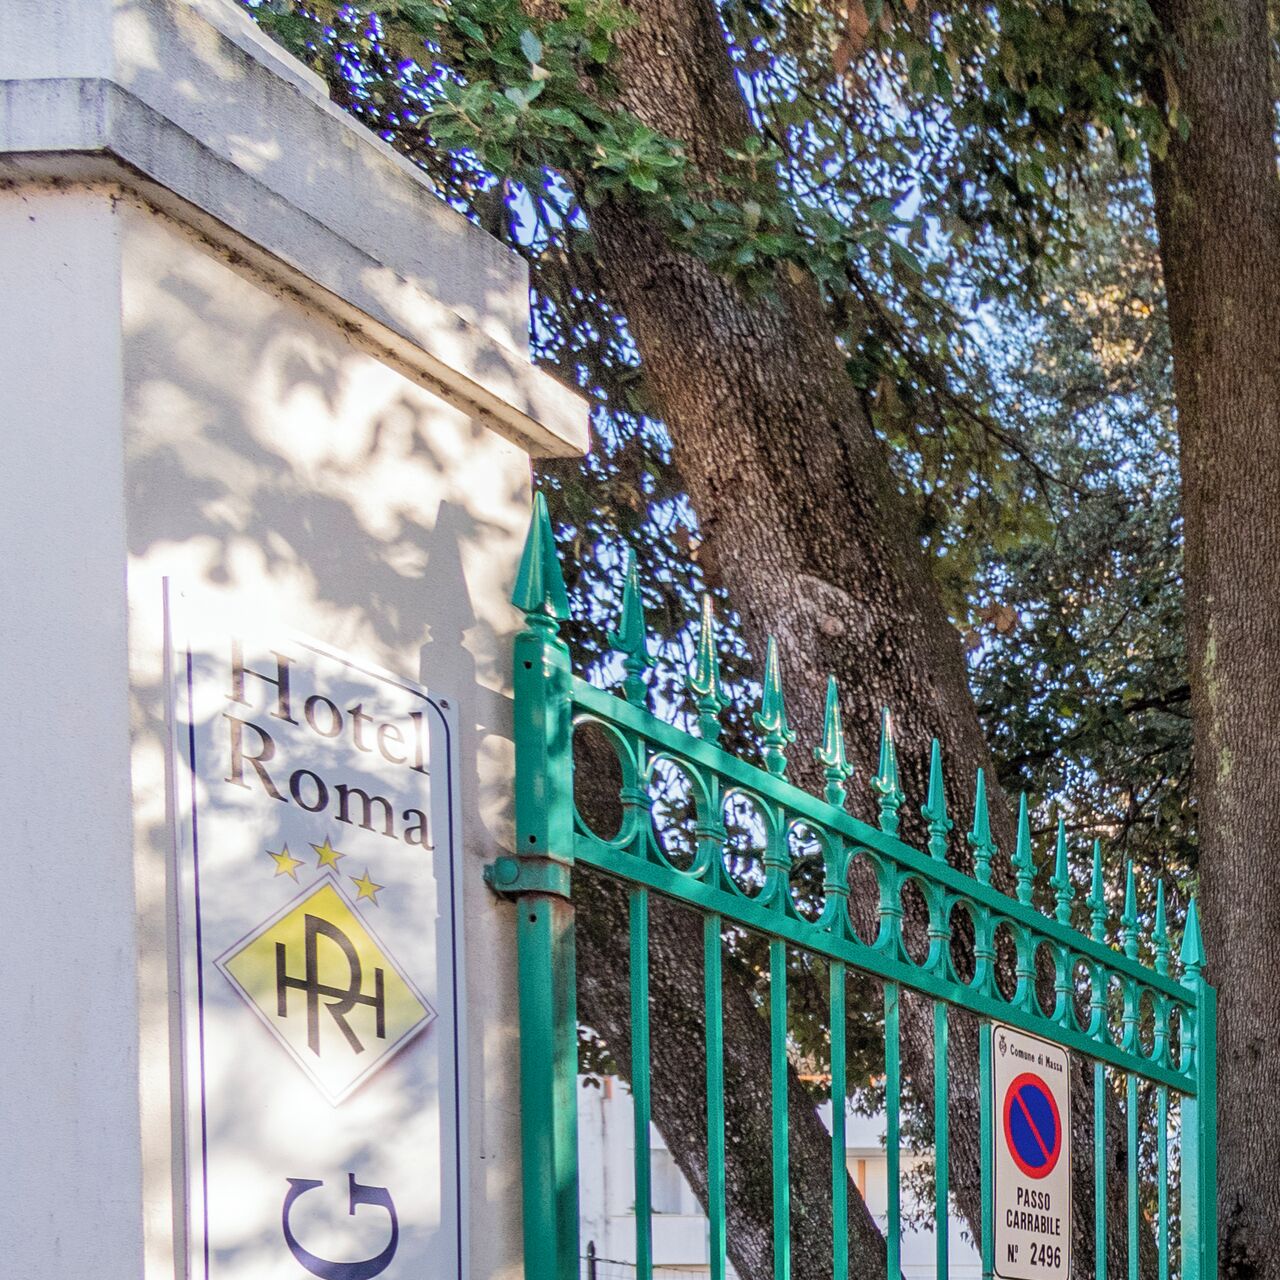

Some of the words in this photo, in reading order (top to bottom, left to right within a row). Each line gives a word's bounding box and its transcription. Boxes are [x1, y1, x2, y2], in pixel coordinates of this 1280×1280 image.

[223, 635, 430, 775] Hotel
[222, 712, 435, 852] Roma
[1010, 1043, 1035, 1063] Comune
[1037, 1053, 1044, 1066] di
[1045, 1056, 1063, 1072] Massa
[1016, 1186, 1050, 1211] PASSO
[1006, 1208, 1061, 1236] CARRABILE
[1029, 1242, 1062, 1269] 2496
